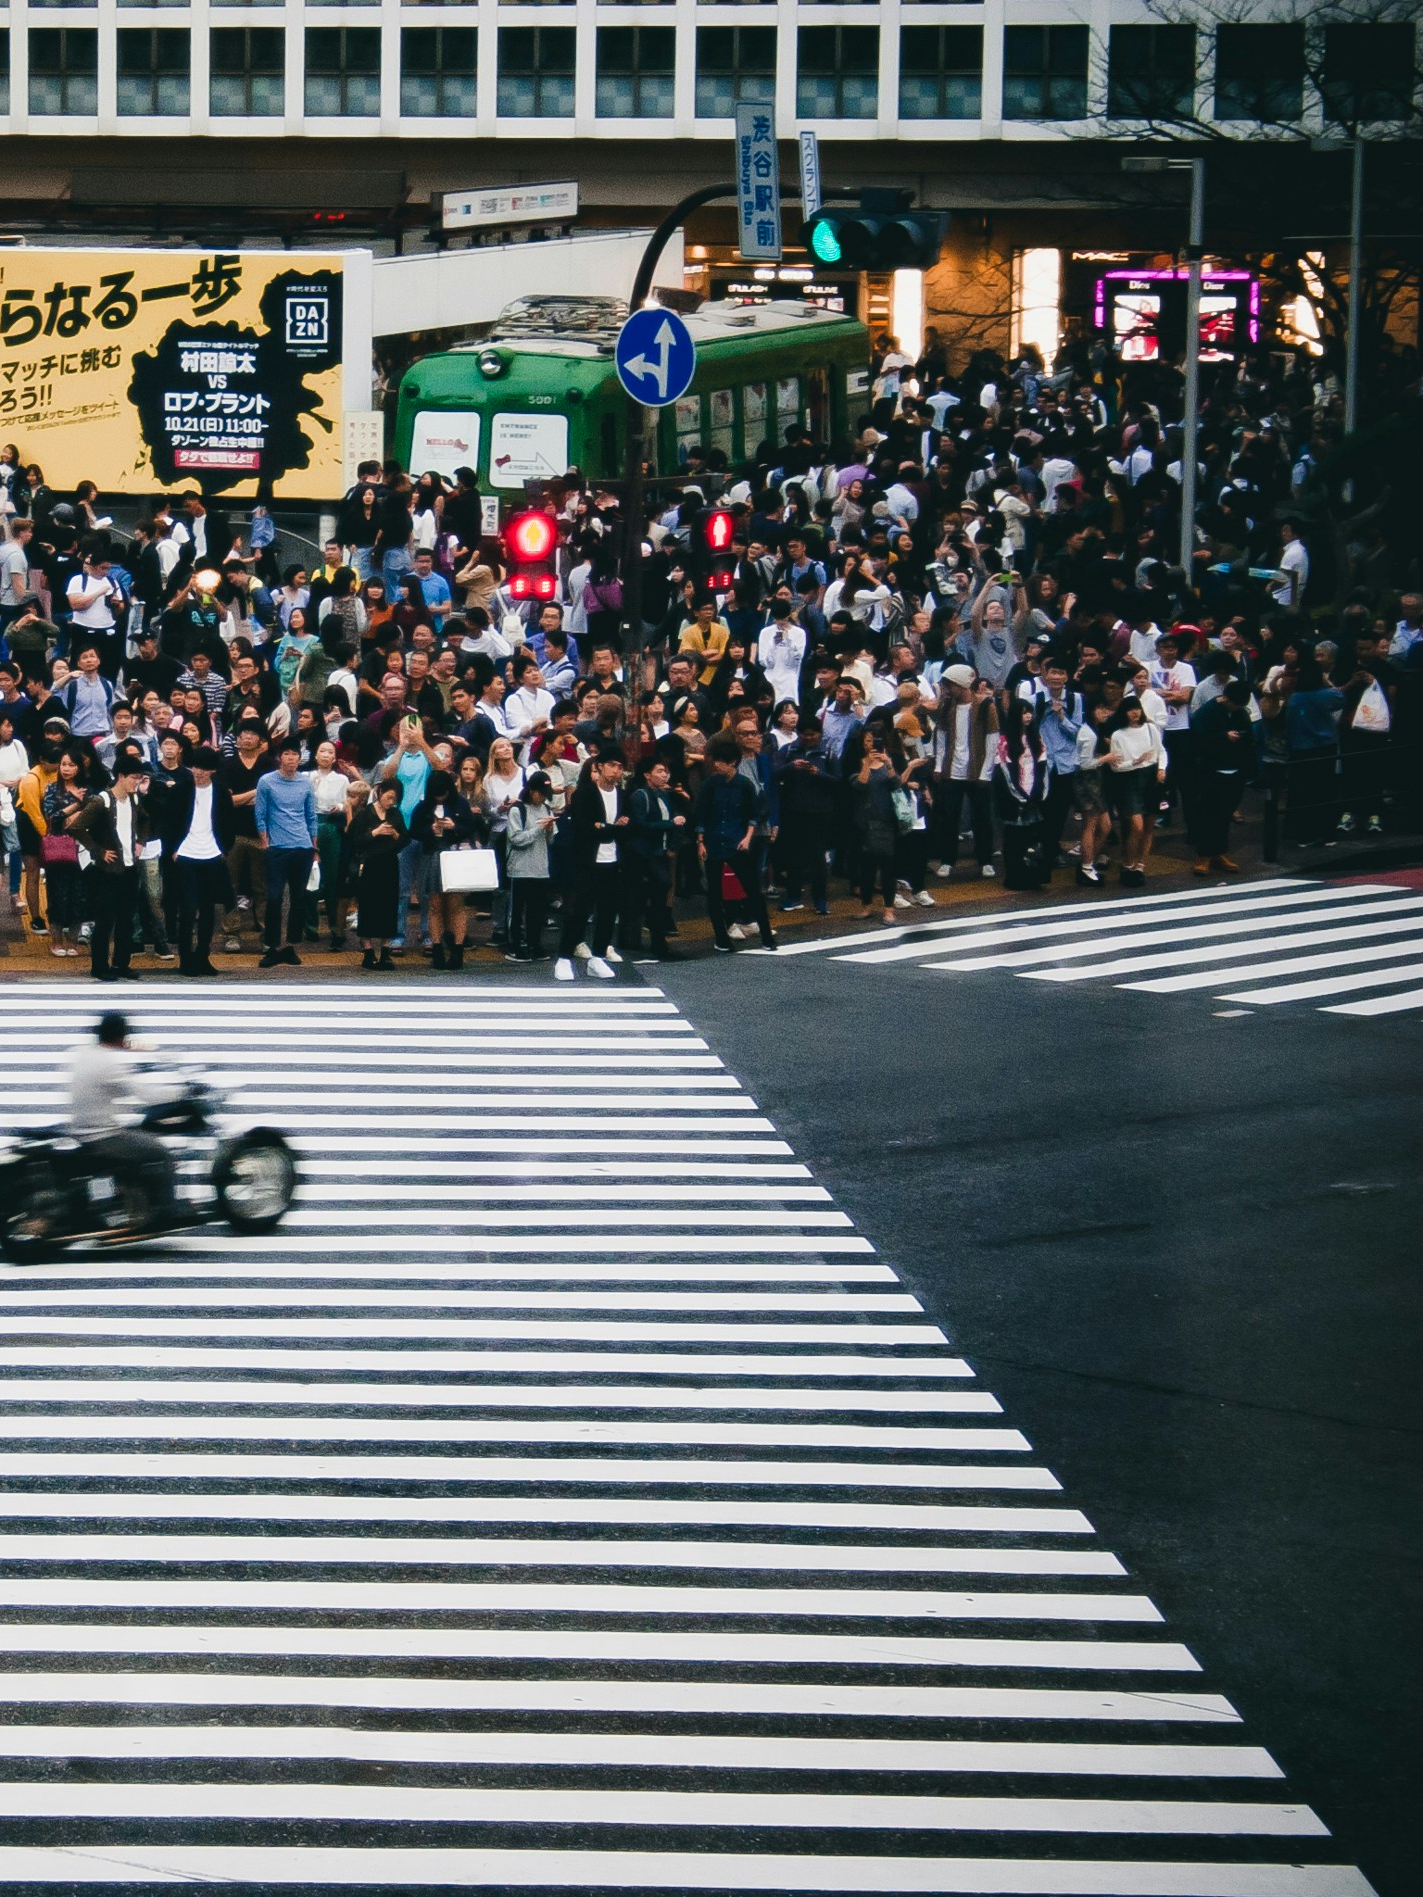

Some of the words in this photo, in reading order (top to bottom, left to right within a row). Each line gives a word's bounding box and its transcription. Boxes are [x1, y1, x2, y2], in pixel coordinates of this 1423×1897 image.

[740, 135, 752, 195] Shibuya
[752, 115, 775, 247] 渋谷駅前
[180, 350, 256, 373] 村田諒太
[207, 374, 227, 389] VS
